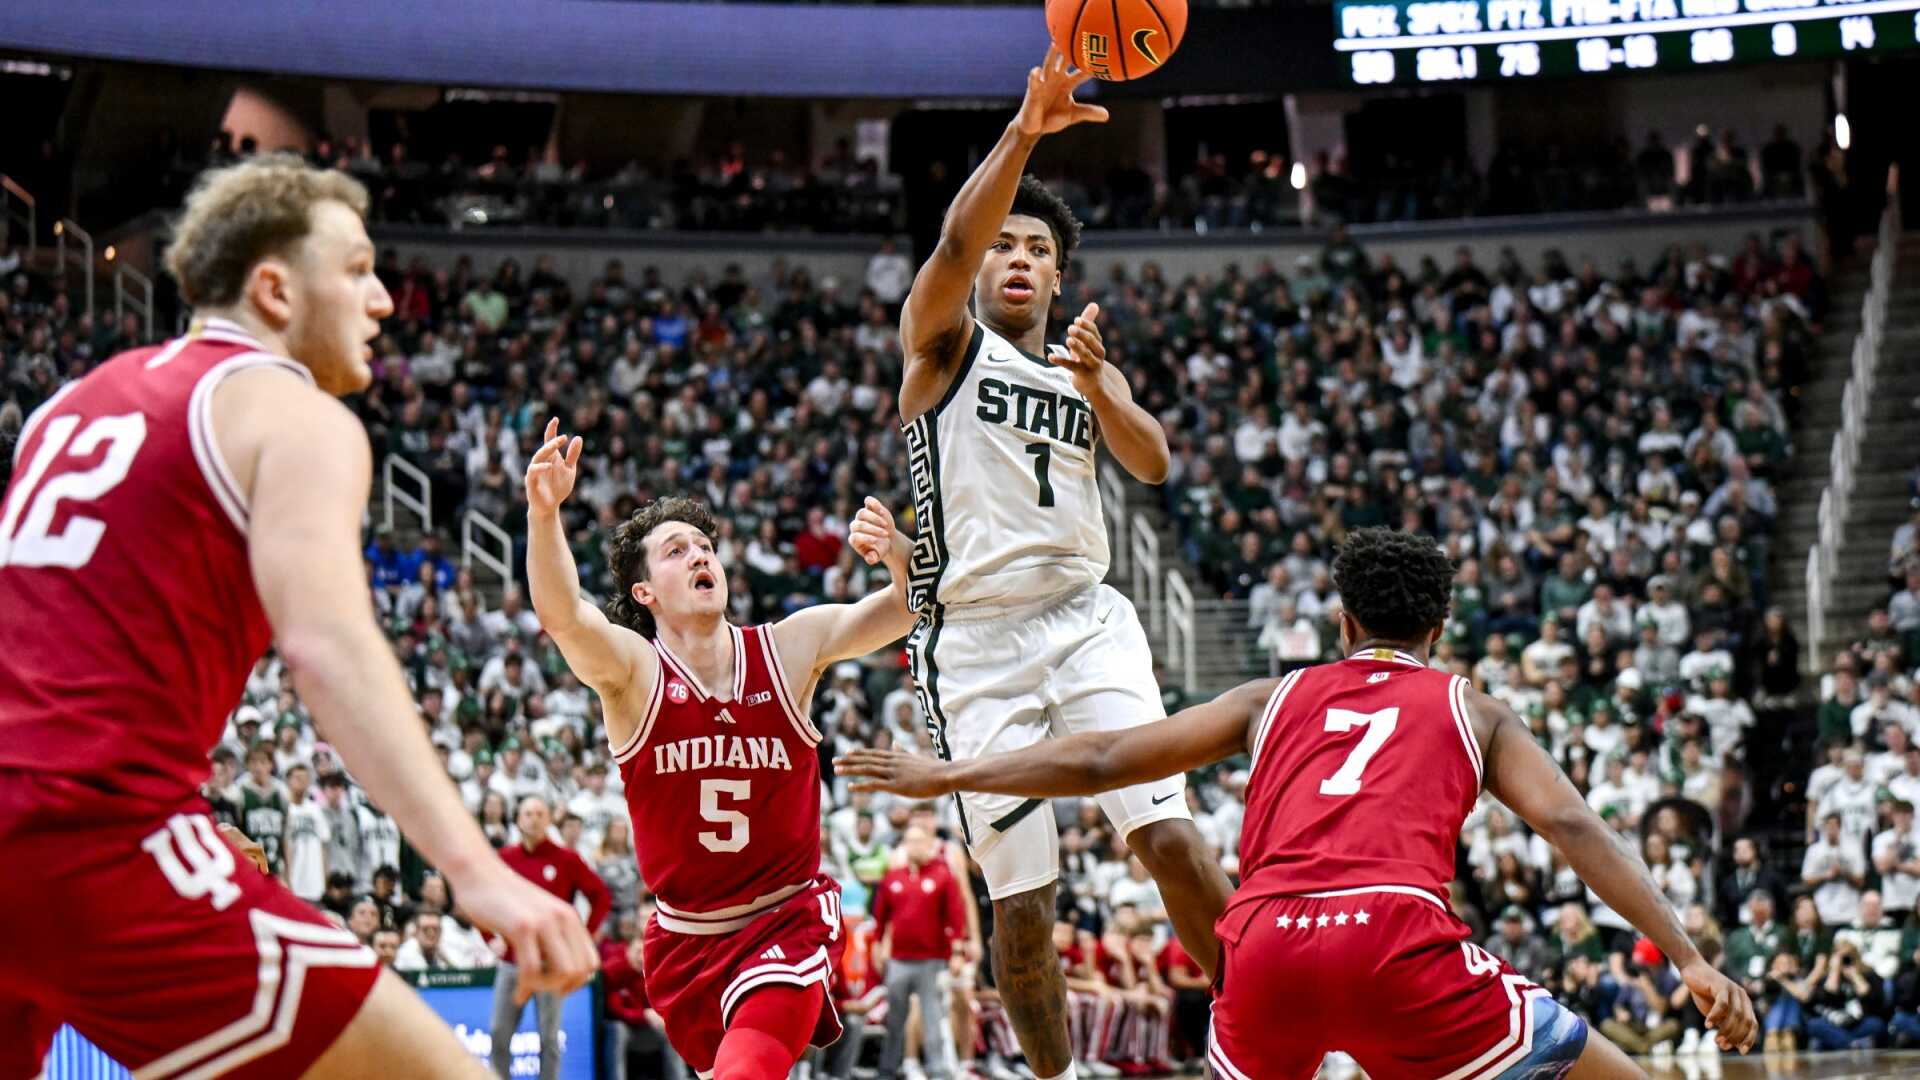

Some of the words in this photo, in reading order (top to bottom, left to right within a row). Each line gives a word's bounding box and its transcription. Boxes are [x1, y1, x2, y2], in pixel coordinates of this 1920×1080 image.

[976, 377, 1092, 451] STATE
[0, 411, 147, 569] 12
[1025, 442, 1055, 507] 1
[654, 735, 792, 775] INDIANA
[1319, 707, 1400, 795] 7
[698, 779, 752, 853] 5
